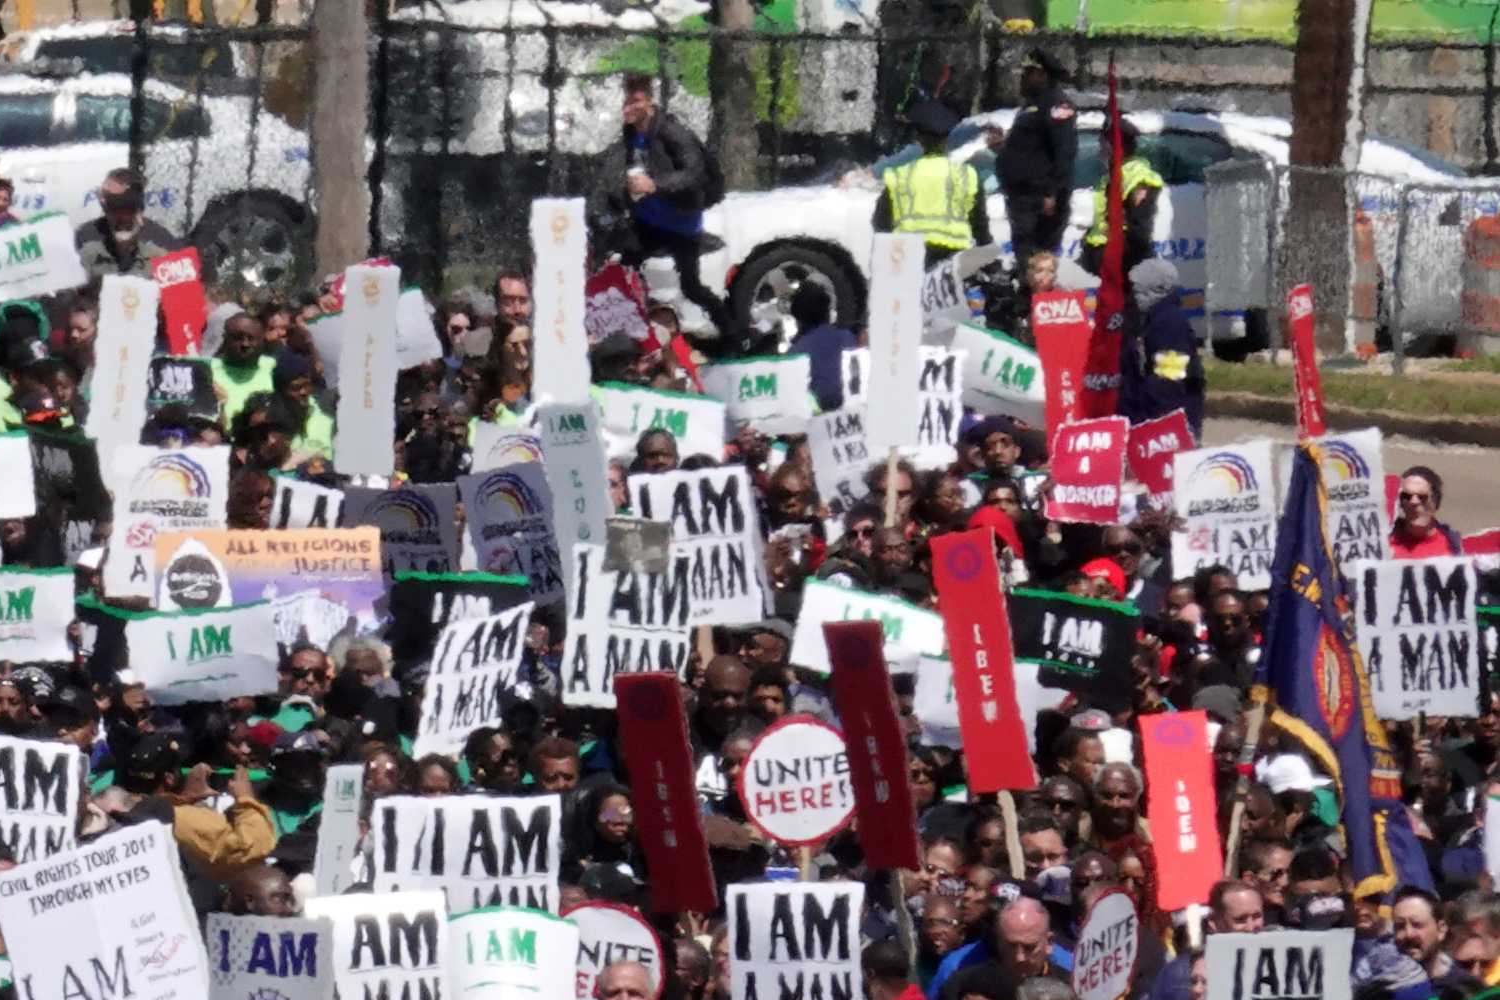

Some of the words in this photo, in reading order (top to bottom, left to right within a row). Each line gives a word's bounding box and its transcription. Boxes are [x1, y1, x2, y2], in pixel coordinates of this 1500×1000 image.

[8, 234, 43, 267] AM
[1034, 300, 1084, 321] CWA
[738, 373, 777, 399] AM
[997, 358, 1035, 391] AM
[650, 406, 688, 438] AM
[1076, 432, 1112, 452] AM
[673, 475, 744, 535] AM
[1053, 485, 1117, 507] WORKER
[226, 540, 258, 554] ALL
[1231, 525, 1270, 552] AM
[1336, 511, 1380, 540] AM
[291, 557, 370, 576] JUSTICE
[574, 552, 588, 619] I
[1365, 568, 1377, 624] I
[1395, 564, 1468, 624] AM
[188, 624, 233, 660] AM
[438, 631, 454, 674] I
[460, 614, 519, 669] AM
[1043, 612, 1055, 645] I
[1059, 618, 1102, 655] AM
[568, 635, 590, 693] A
[973, 623, 997, 723] IBEW
[1368, 637, 1384, 692] A
[1399, 631, 1469, 691] MAN
[754, 752, 850, 787] UNITE
[754, 777, 848, 817] HERE!
[463, 804, 551, 876] AM
[0, 877, 32, 897] CIVIL
[35, 858, 83, 888] RIGHTS
[84, 847, 119, 872] TOUR
[29, 883, 93, 917] THROUGH
[94, 876, 116, 896] MY
[117, 866, 151, 888] EYES
[350, 911, 440, 968] AM
[466, 933, 474, 964] I
[485, 928, 537, 965] AM
[736, 894, 751, 960] I
[769, 893, 851, 961] AM
[1078, 916, 1135, 966] UNITE
[218, 930, 231, 973] I
[248, 932, 319, 978] AM
[1078, 942, 1132, 995] HERE!
[1252, 946, 1324, 1000] AM
